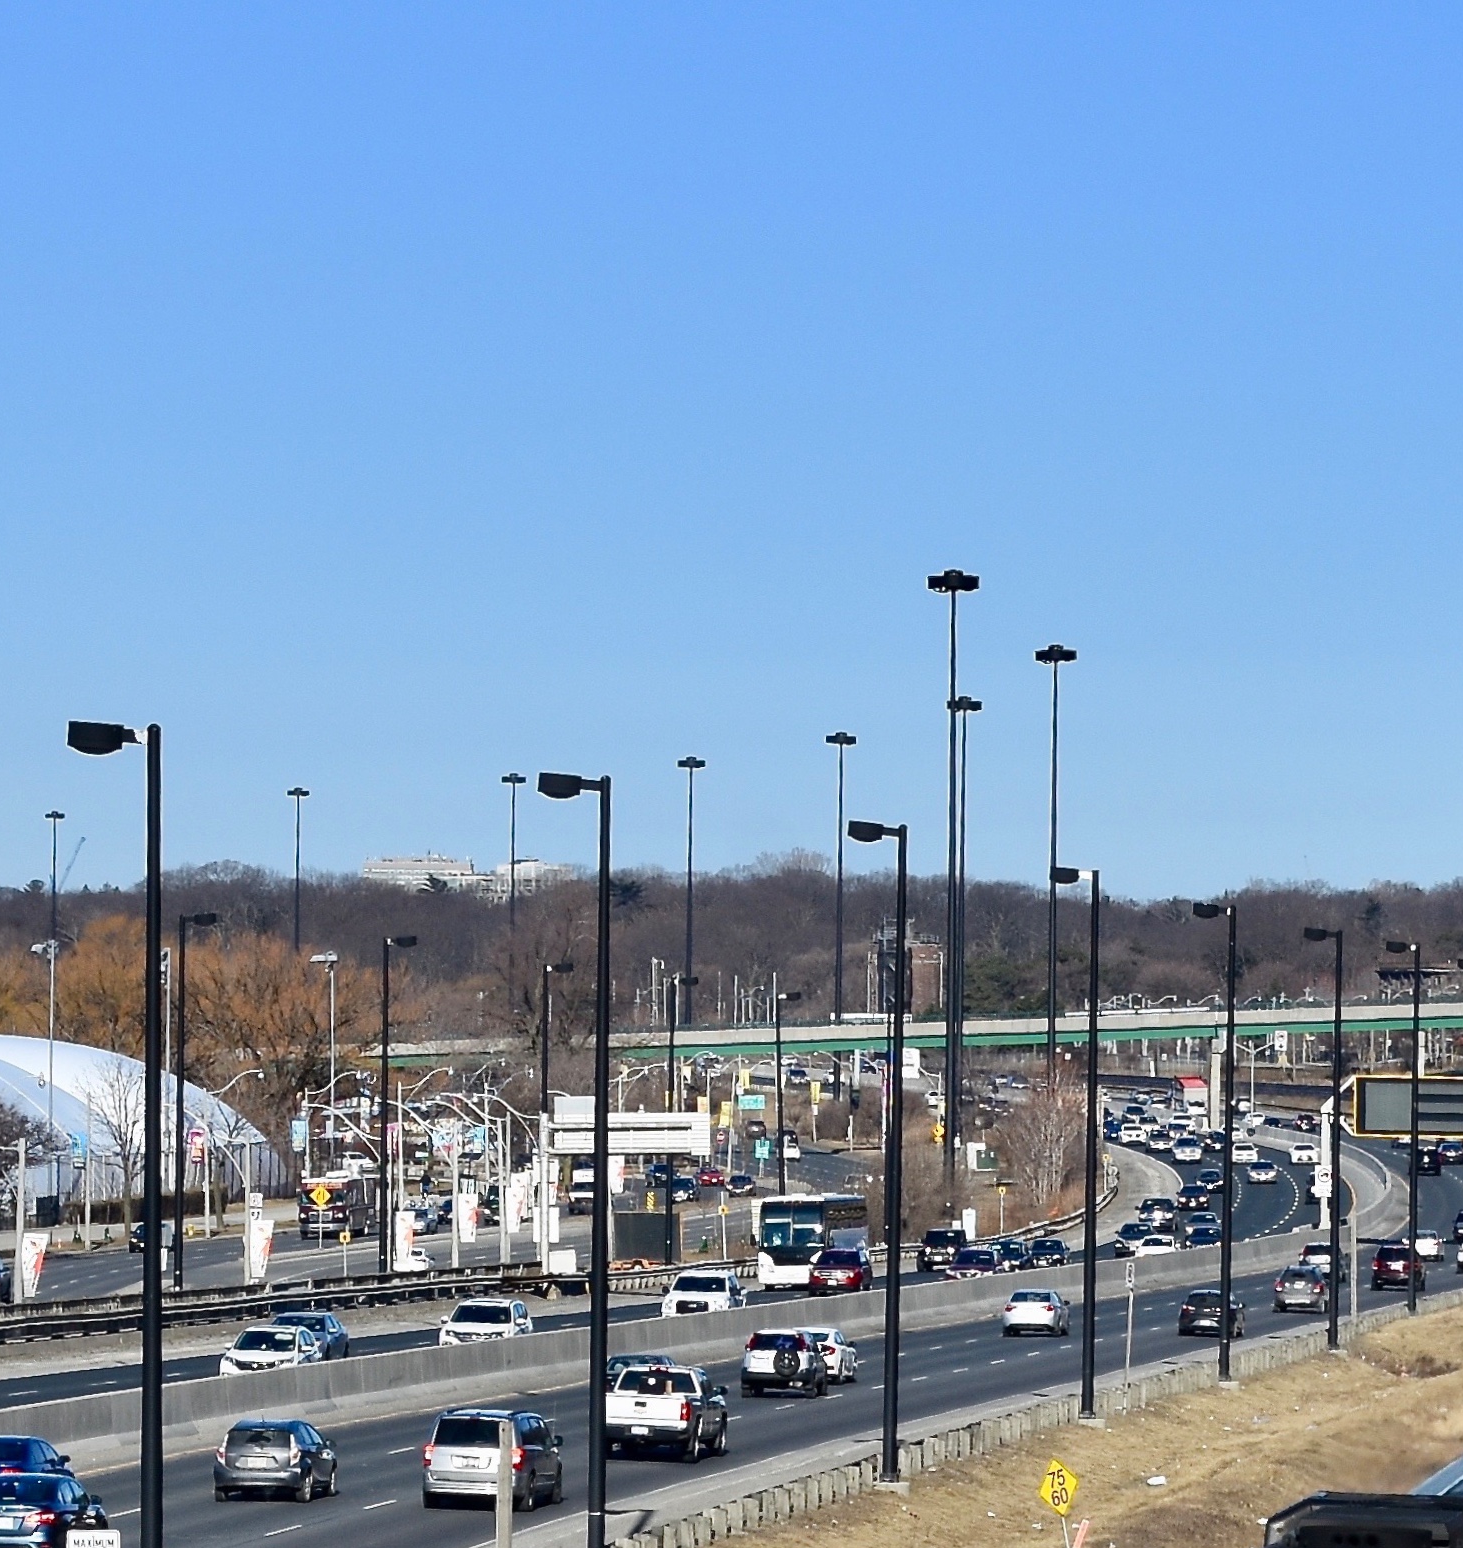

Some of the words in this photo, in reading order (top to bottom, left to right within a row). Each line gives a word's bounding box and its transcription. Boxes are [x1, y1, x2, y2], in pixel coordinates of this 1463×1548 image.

[1046, 1468, 1066, 1489] 75
[1051, 1487, 1069, 1507] 60
[73, 1536, 114, 1548] MAXIMUM
